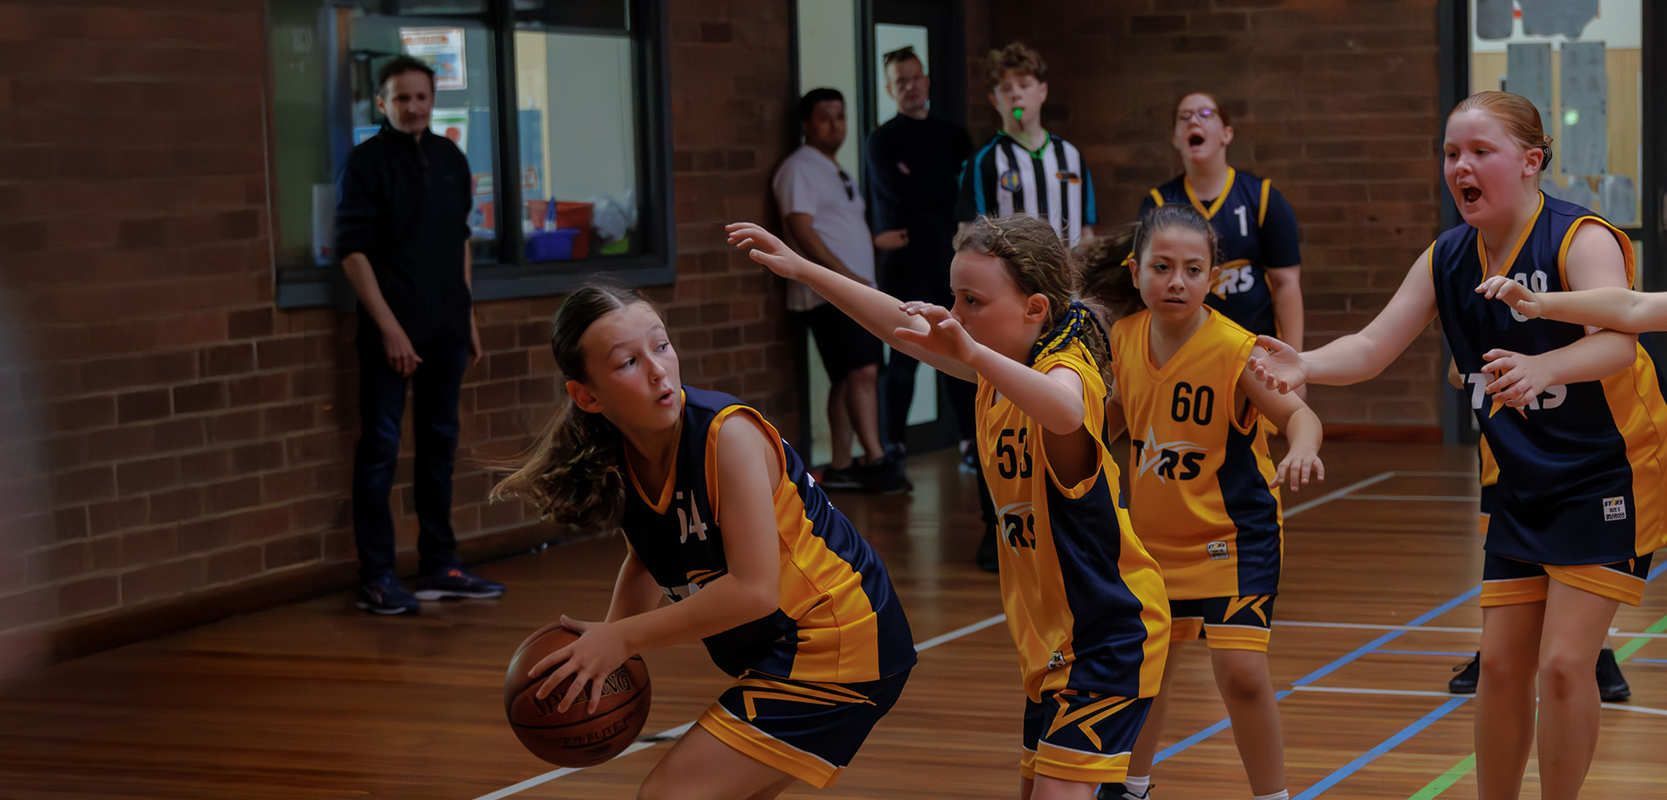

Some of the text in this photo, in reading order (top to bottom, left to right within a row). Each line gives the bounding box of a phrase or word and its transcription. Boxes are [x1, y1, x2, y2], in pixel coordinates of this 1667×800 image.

[1233, 204, 1248, 237] 1
[1171, 382, 1214, 426] 60
[997, 428, 1032, 479] 53
